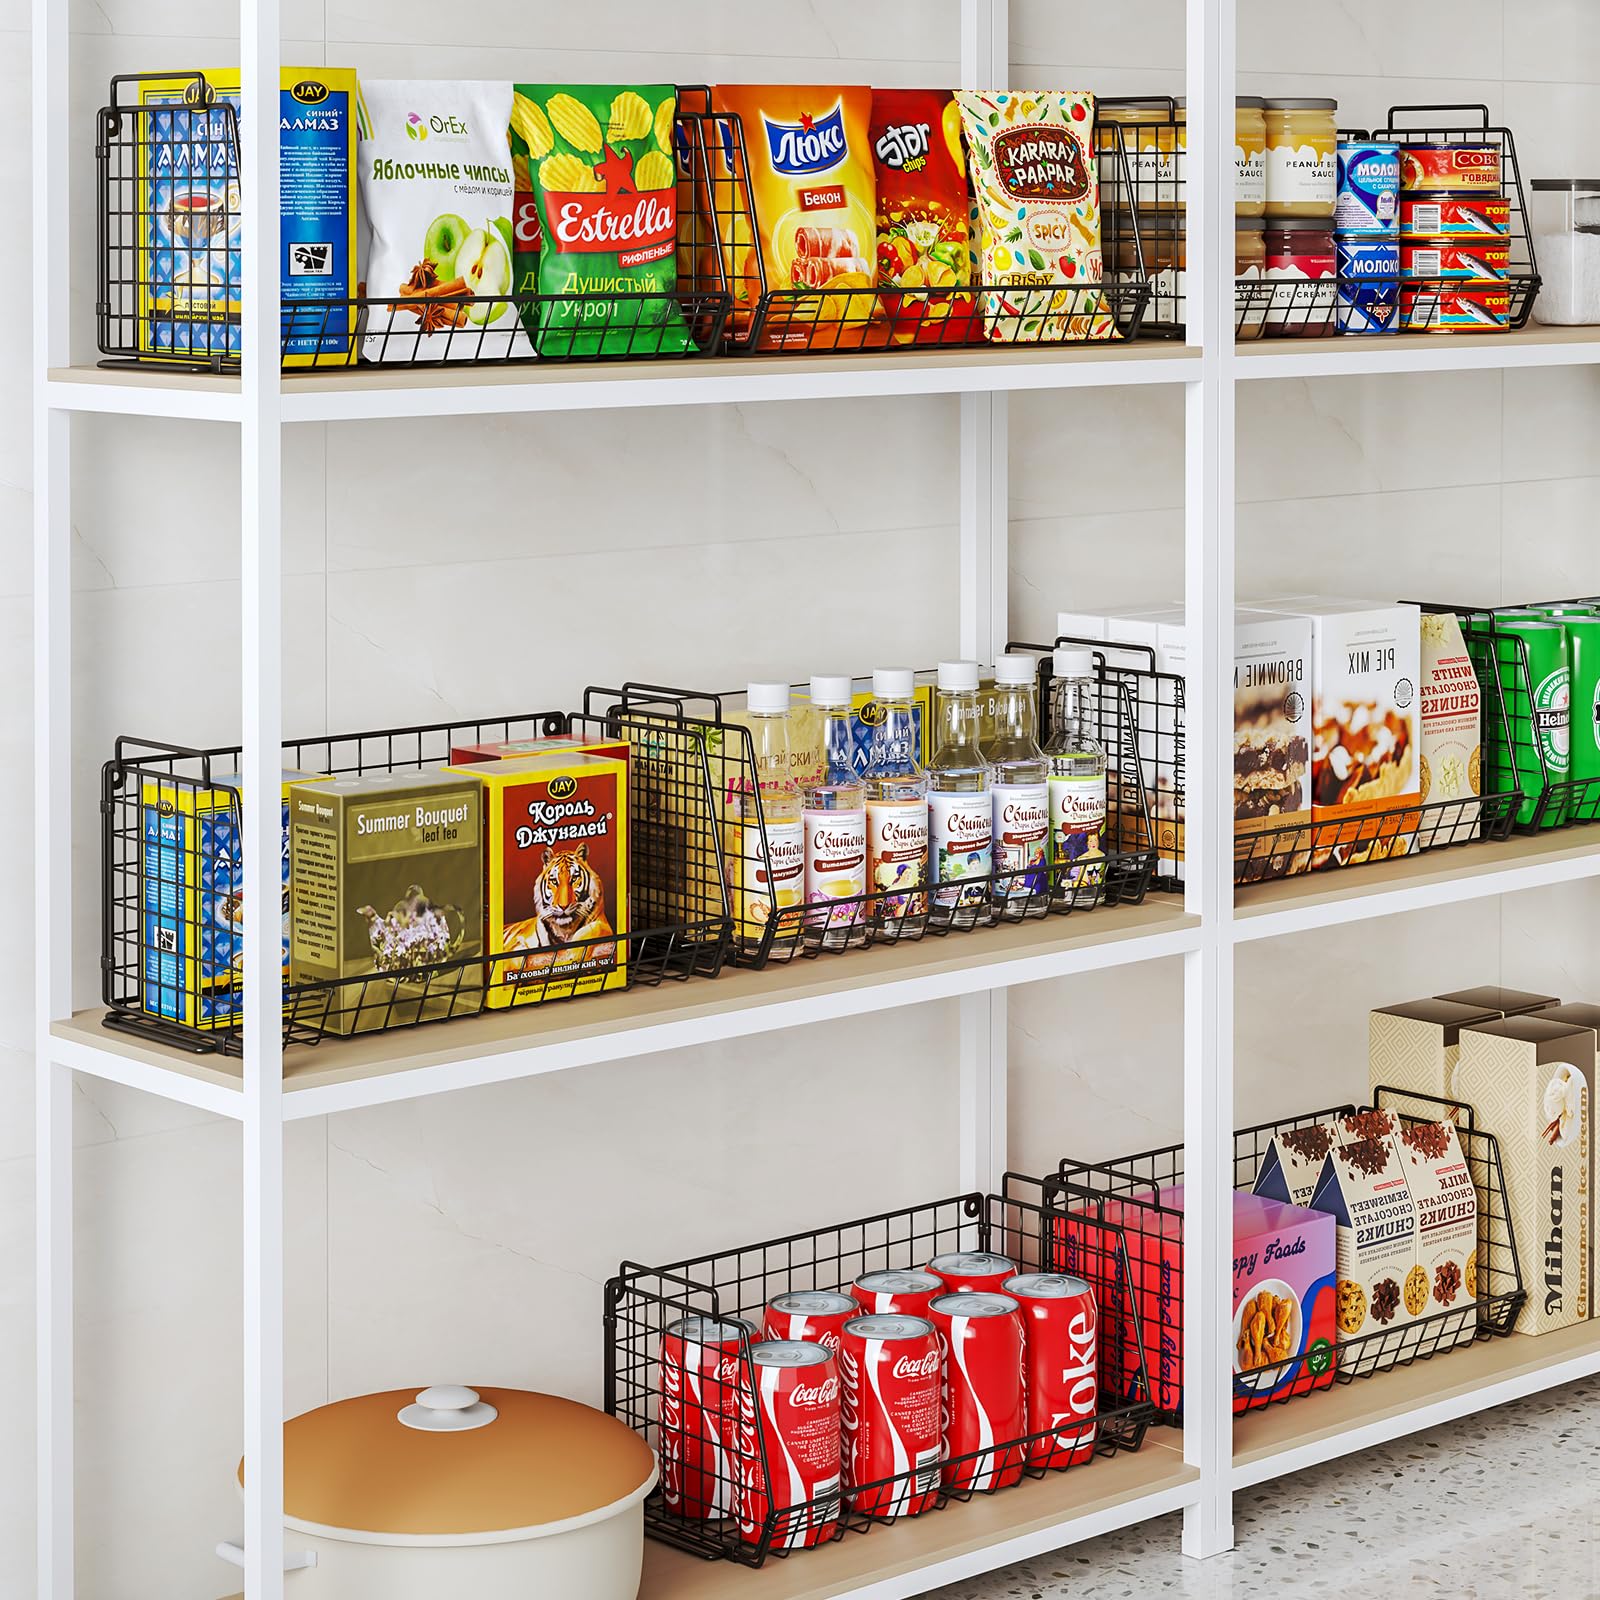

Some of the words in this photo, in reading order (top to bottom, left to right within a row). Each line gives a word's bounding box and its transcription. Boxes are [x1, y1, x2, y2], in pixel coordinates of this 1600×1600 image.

[296, 86, 323, 97] JAY
[280, 118, 339, 131] АЛМАЗ
[430, 115, 468, 135] OrEx
[773, 125, 844, 167] Люкс
[1007, 140, 1076, 166] KARARAY
[372, 159, 460, 181] Яблочные
[463, 163, 511, 184] чипсы
[903, 156, 927, 173] chips
[1014, 163, 1077, 187] PAAPAR
[1286, 160, 1324, 168] PEANUT
[1311, 170, 1335, 178] SAUCE
[803, 192, 841, 206] Бекон
[556, 197, 673, 243] Estrella
[621, 243, 673, 265] РИФЛЕНЫЕ
[561, 271, 657, 295] Душистый
[1296, 291, 1327, 299] CREAM
[560, 300, 618, 321] Укроп
[551, 780, 573, 794] JAY
[357, 814, 410, 836] Summer
[415, 803, 468, 828] Bouquet
[528, 800, 594, 825] Король
[422, 826, 440, 843] leaf
[443, 827, 457, 841] tea
[515, 815, 607, 848] Джунглей
[1579, 1086, 1588, 1158] cream
[1577, 1163, 1588, 1196] ice
[1577, 1202, 1588, 1319] Cinnamon
[1051, 1310, 1097, 1452] Coke
